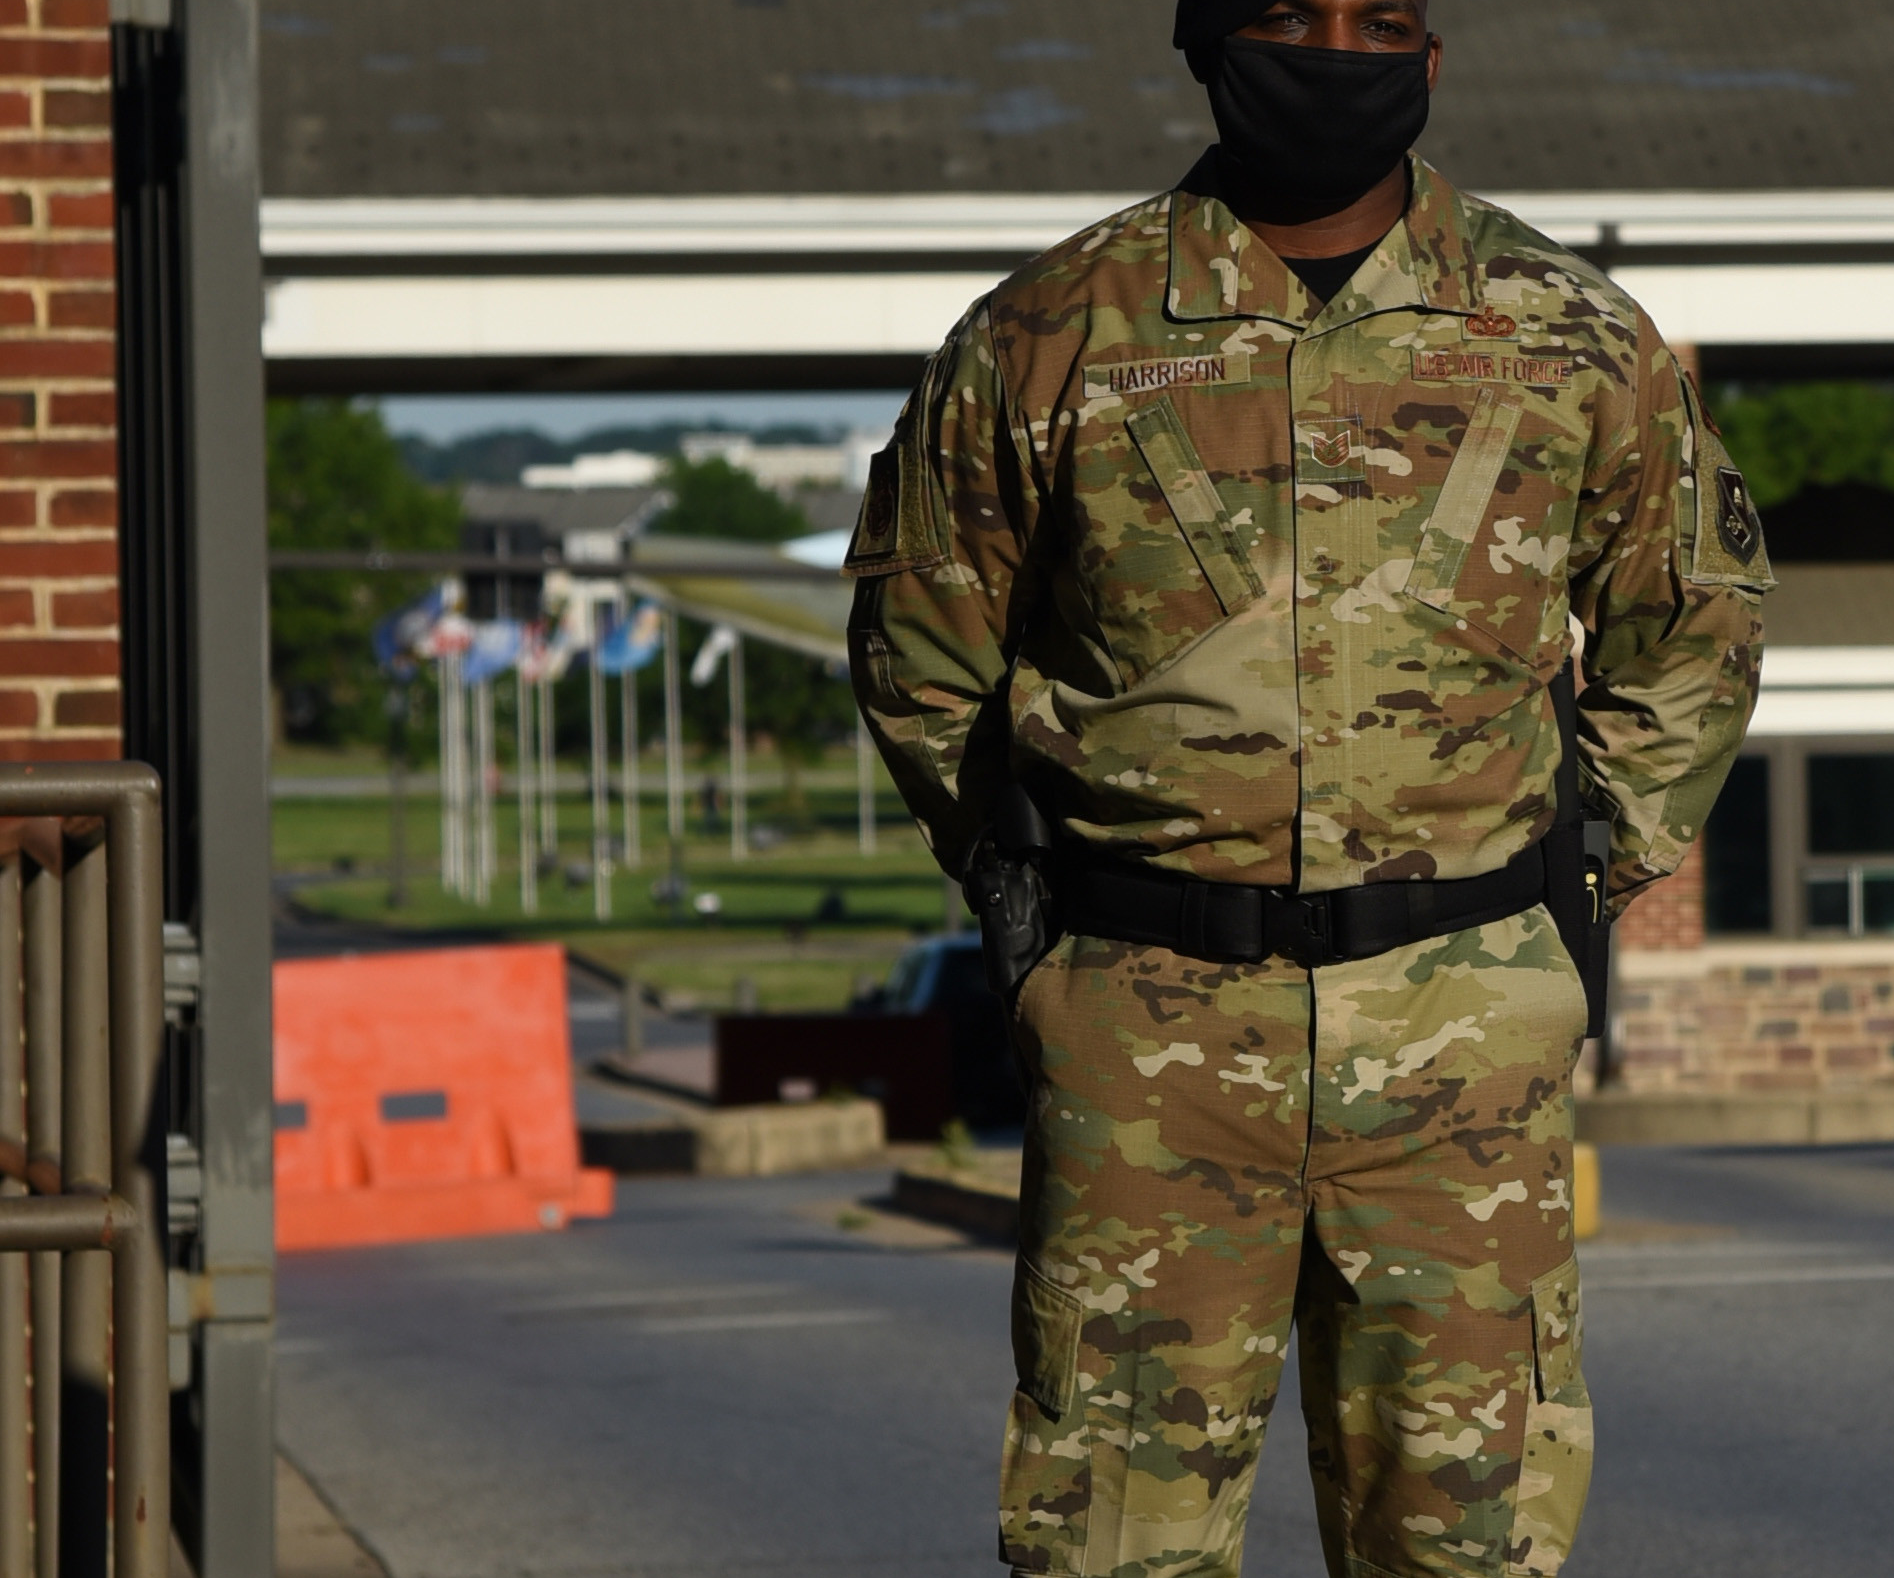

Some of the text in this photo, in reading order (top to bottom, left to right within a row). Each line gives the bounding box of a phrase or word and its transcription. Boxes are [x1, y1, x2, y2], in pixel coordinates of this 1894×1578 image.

[1109, 358, 1226, 392] HARRISON
[1415, 353, 1570, 384] US AIR FORCE
